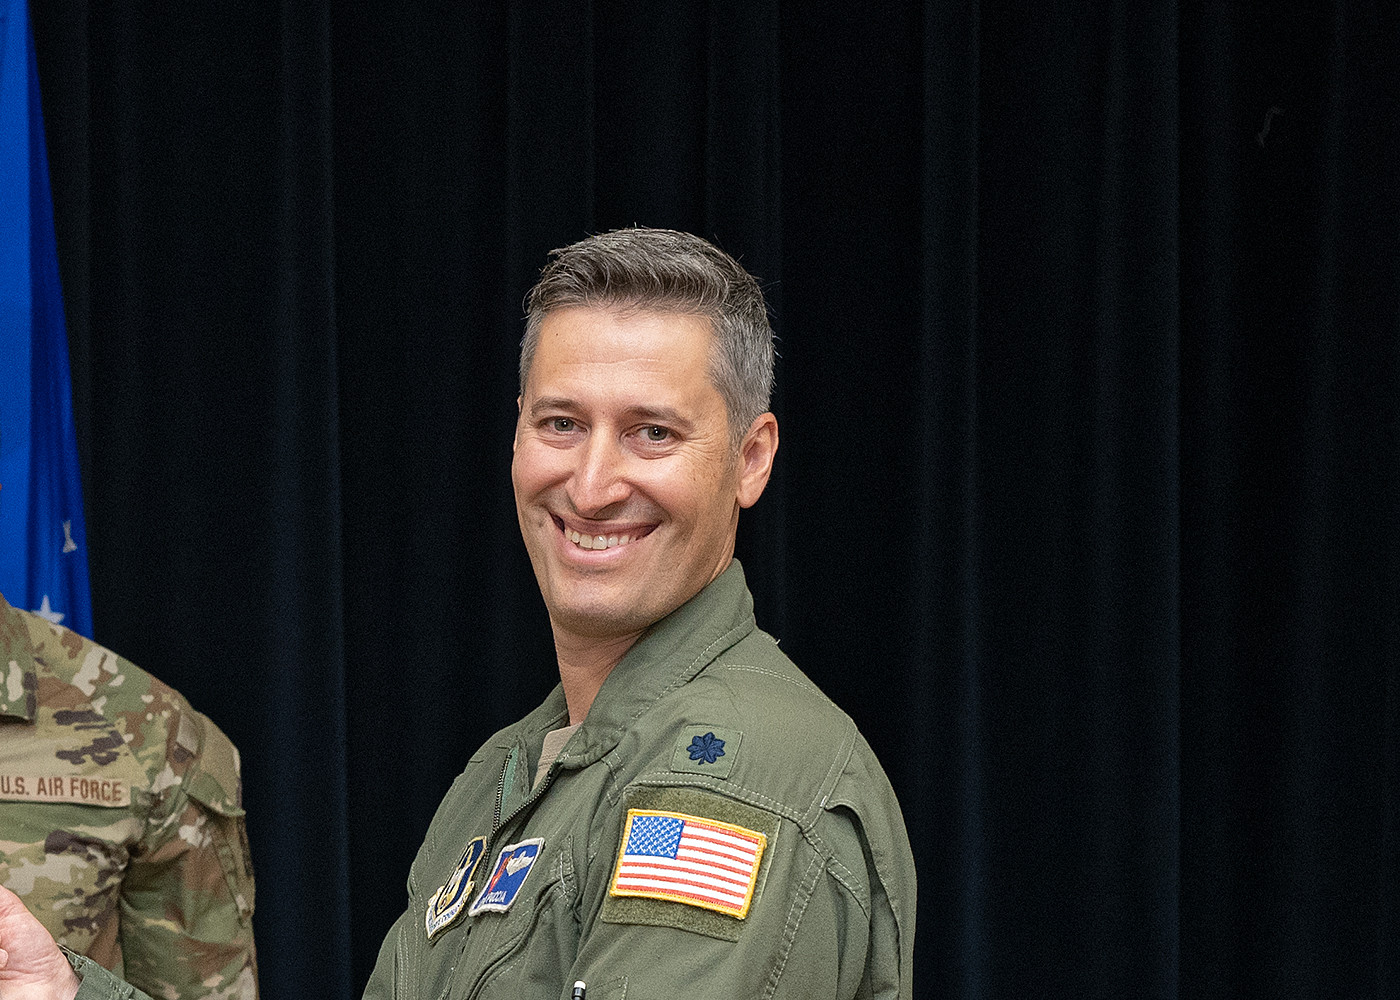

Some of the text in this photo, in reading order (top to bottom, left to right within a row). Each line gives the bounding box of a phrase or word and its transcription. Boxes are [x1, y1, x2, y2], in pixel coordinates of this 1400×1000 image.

[0, 775, 122, 802] U.S. AIR FORCE
